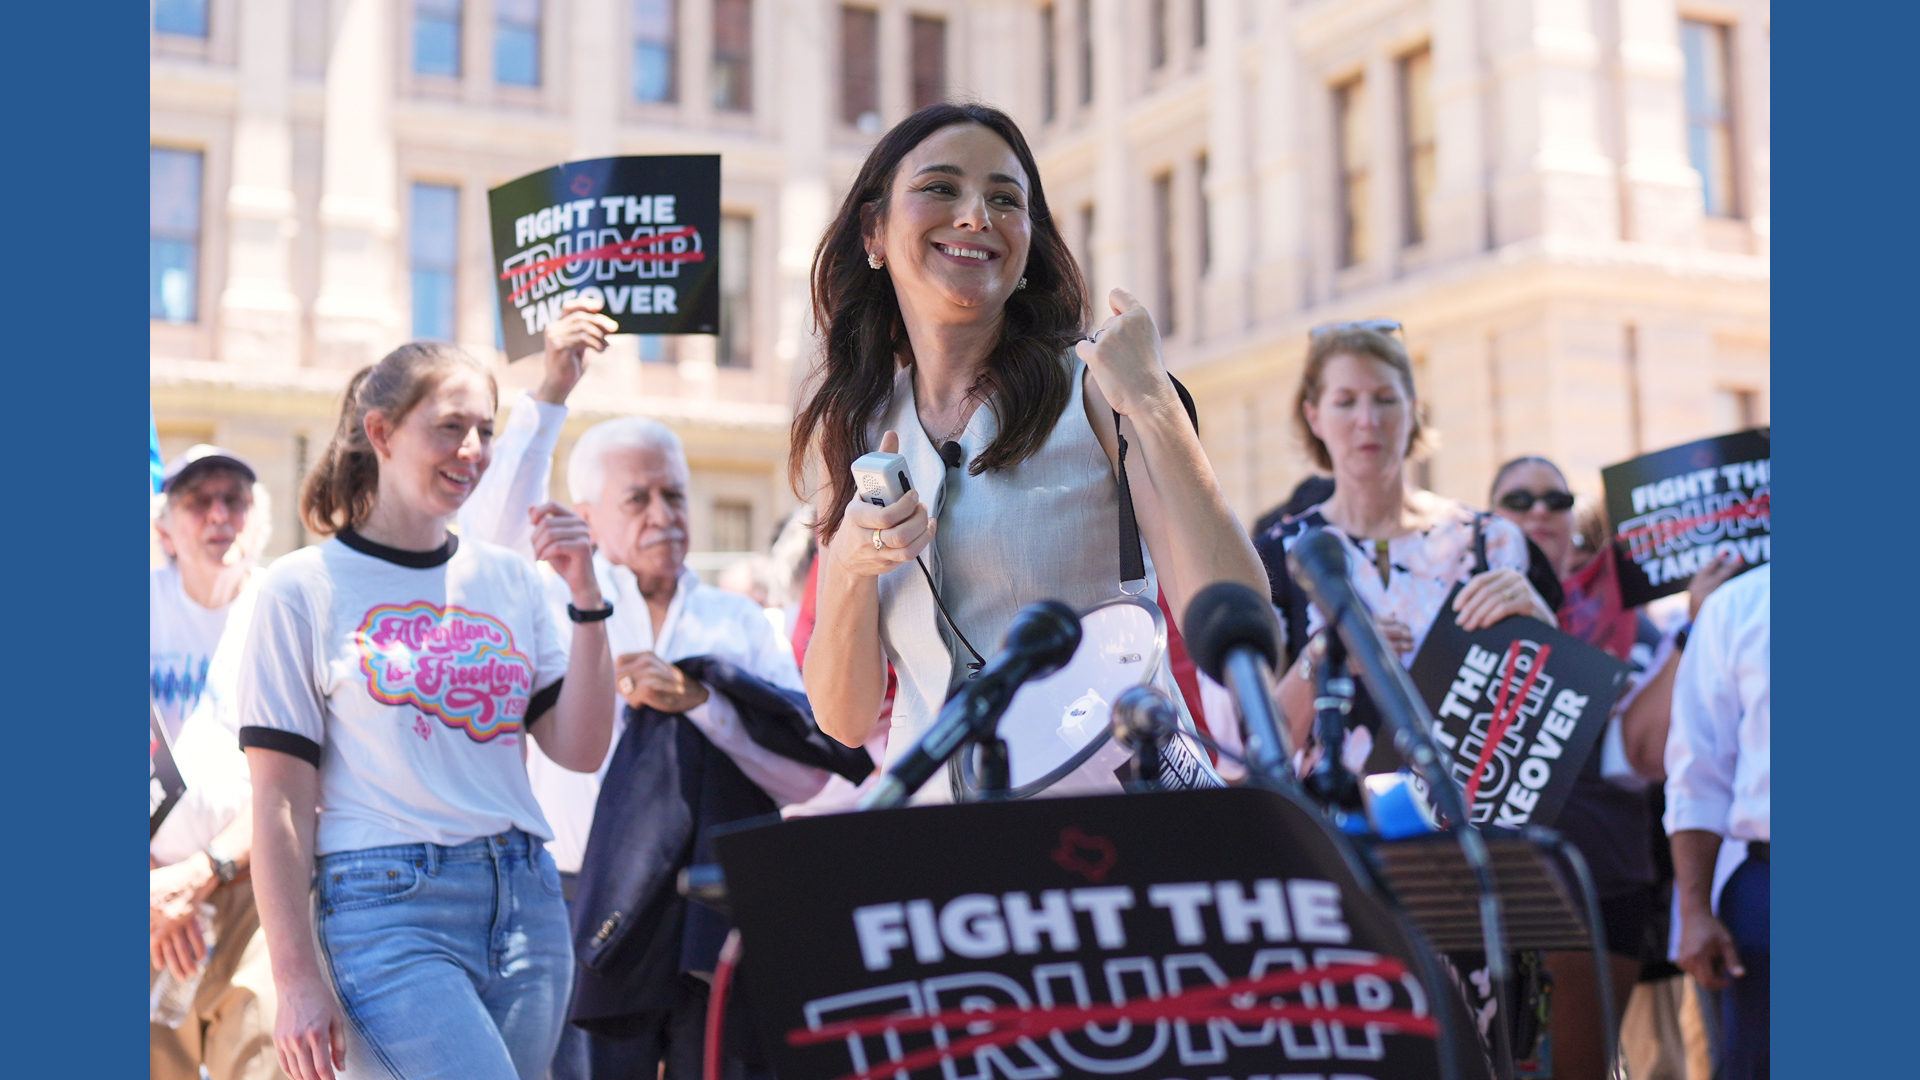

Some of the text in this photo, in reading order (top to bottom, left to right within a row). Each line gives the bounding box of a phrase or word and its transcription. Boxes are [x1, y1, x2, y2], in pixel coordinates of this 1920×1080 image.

[515, 195, 676, 247] FIGHT THE
[503, 225, 703, 308] TRUMP
[521, 285, 678, 335] TAKOVER
[1631, 467, 1718, 514] FIGHT
[415, 657, 529, 724] Freedom
[1439, 643, 1499, 720] THE
[1449, 638, 1555, 832] UMP
[854, 879, 1349, 970] FIGHT THE
[803, 950, 1428, 1080] TRUMP
